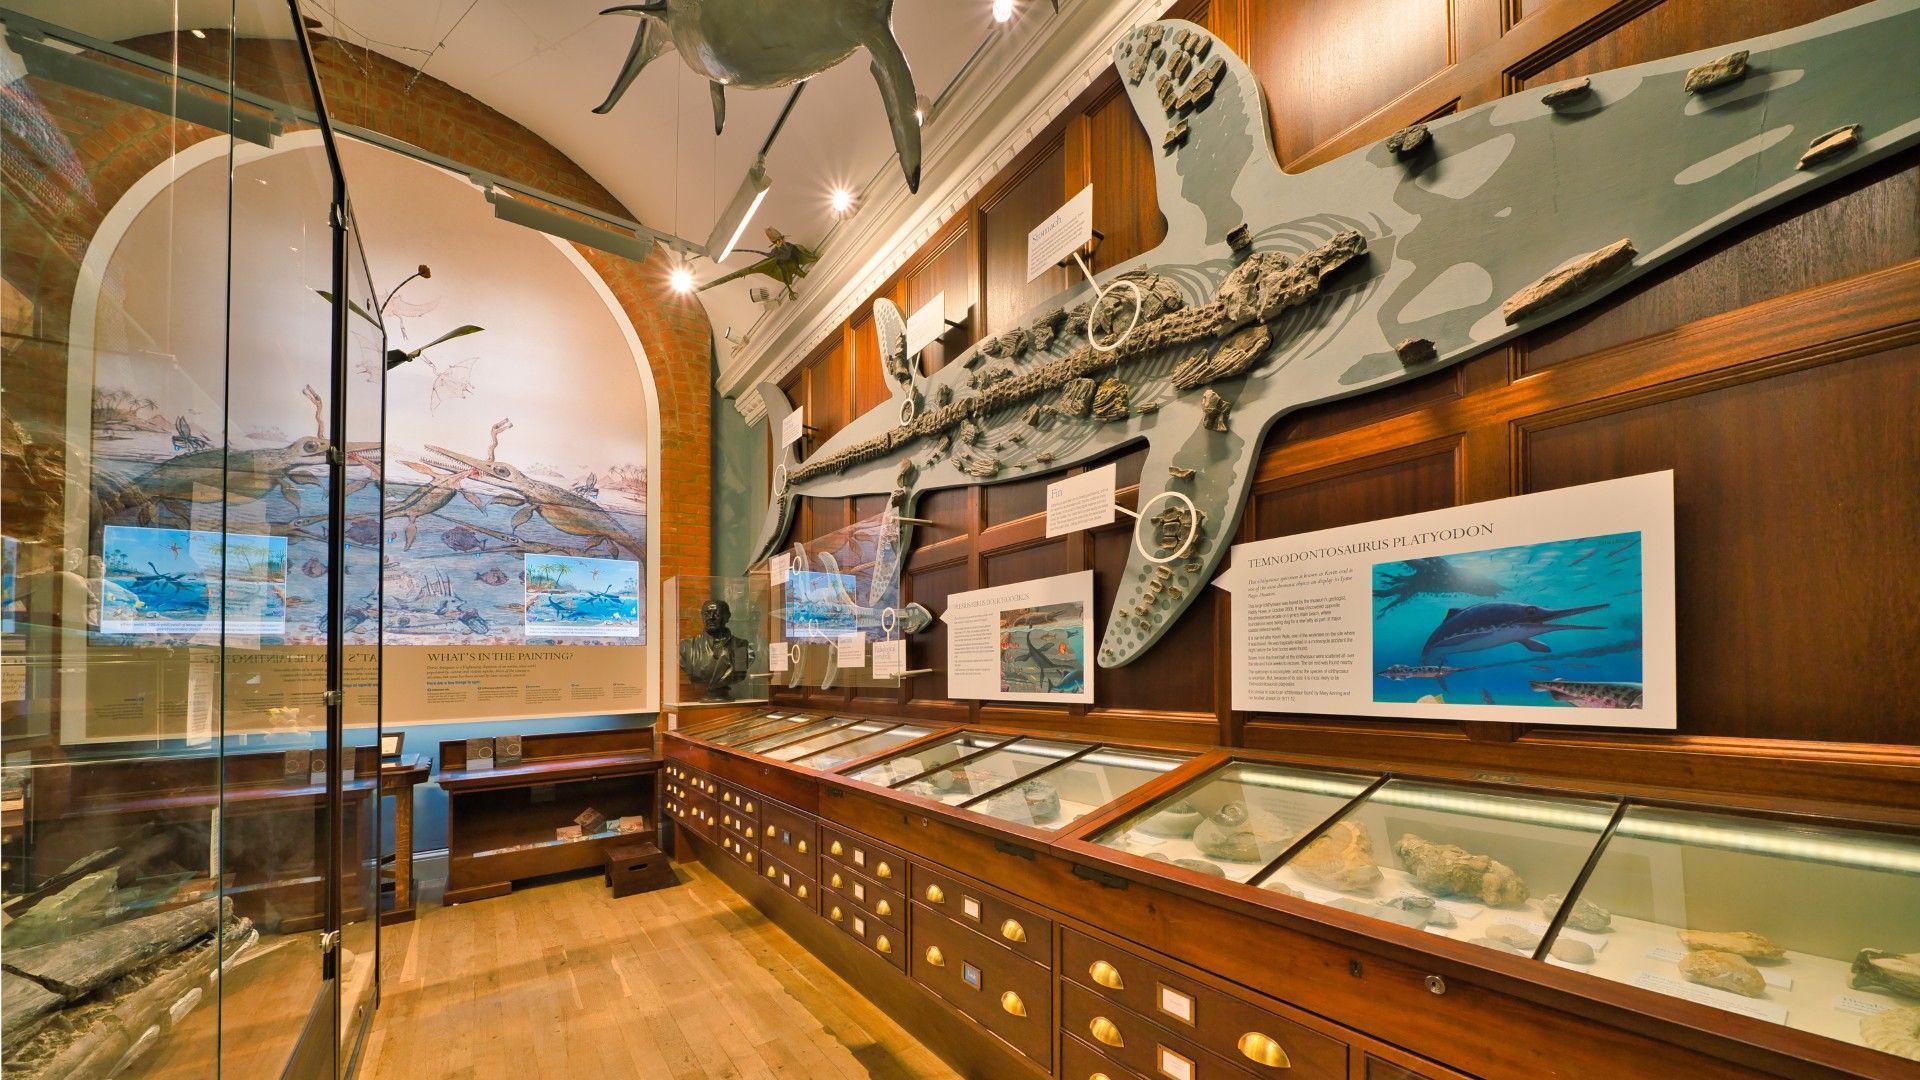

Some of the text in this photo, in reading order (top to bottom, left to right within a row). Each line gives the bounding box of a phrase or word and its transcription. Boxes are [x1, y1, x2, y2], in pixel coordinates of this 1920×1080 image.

[1032, 215, 1062, 241] Stomach
[1247, 523, 1495, 568] TEMNODONTOSAURUS PLATYODON
[427, 652, 573, 661] WHAT'S IN THE PAINTING?
